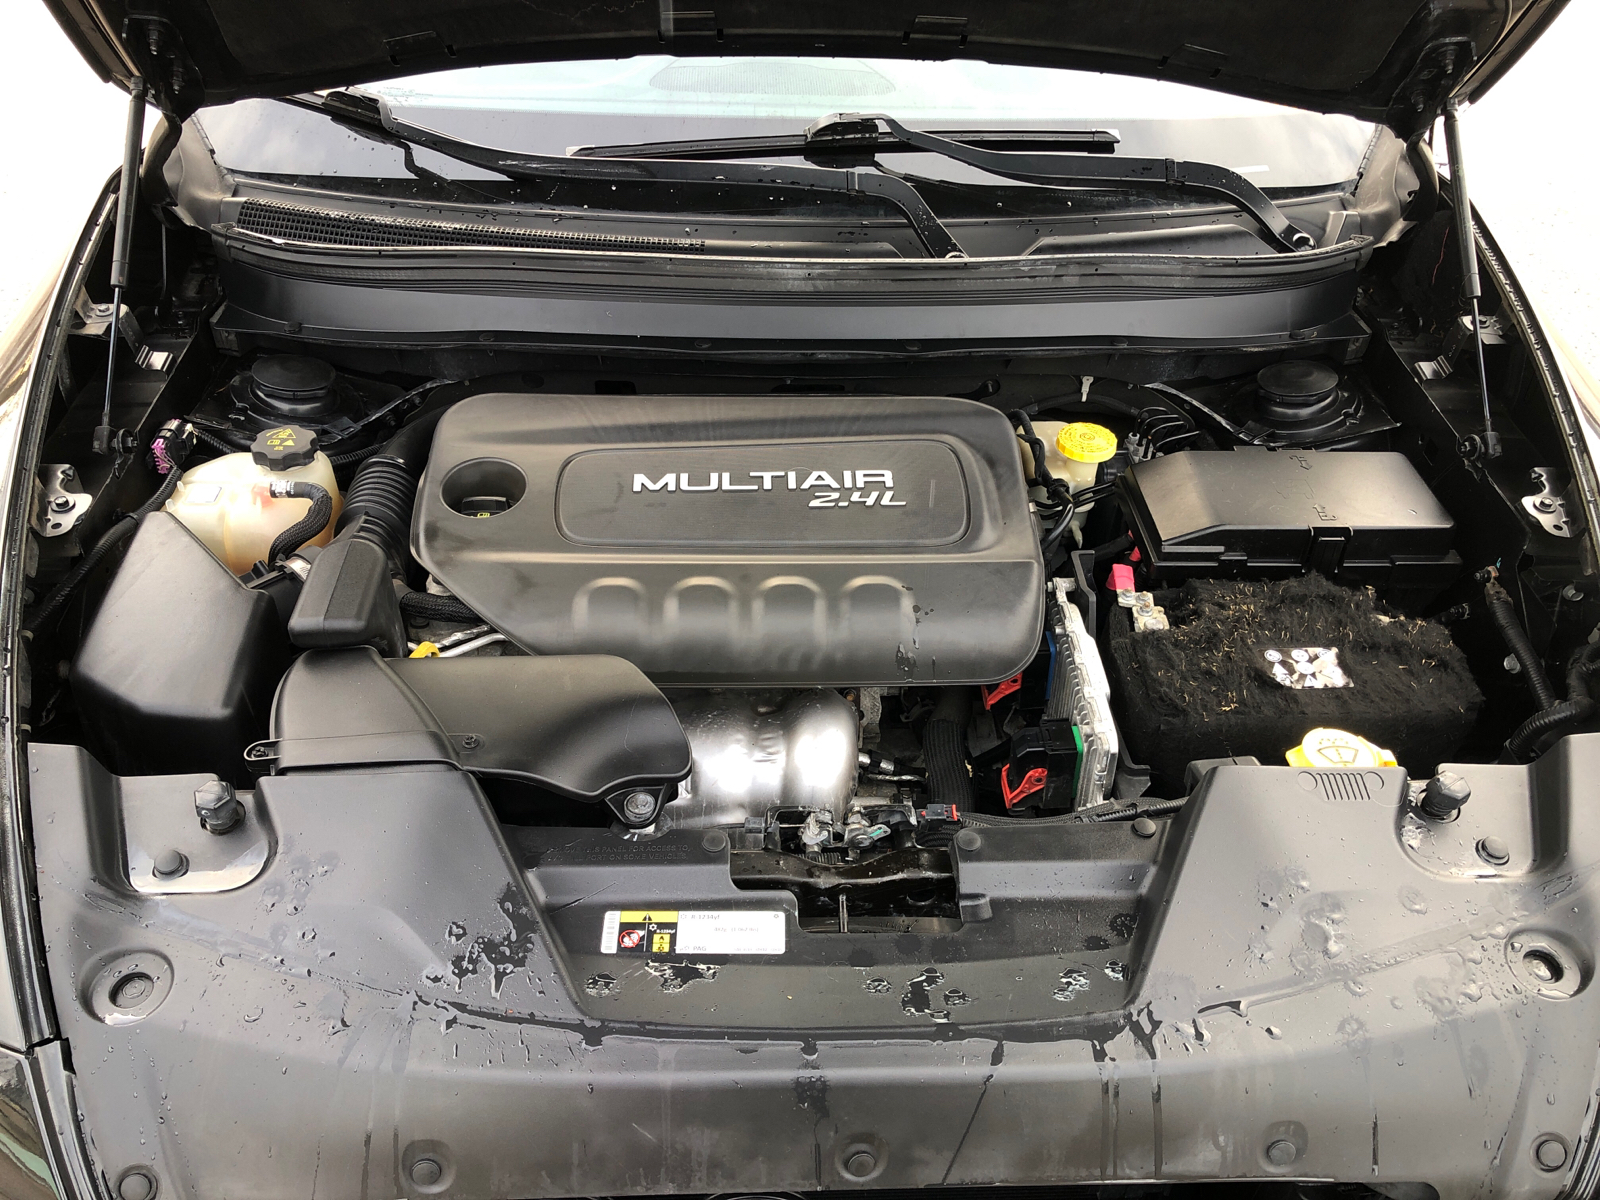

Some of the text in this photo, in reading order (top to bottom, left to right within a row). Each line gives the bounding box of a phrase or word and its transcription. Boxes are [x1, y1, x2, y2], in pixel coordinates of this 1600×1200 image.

[632, 469, 895, 493] MULTIAIR
[807, 490, 907, 508] 2.4L
[601, 845, 627, 853] PANEL
[645, 844, 677, 852] ACCESS
[586, 853, 607, 861] PORT
[608, 853, 622, 861] ON
[622, 852, 647, 860] SOME
